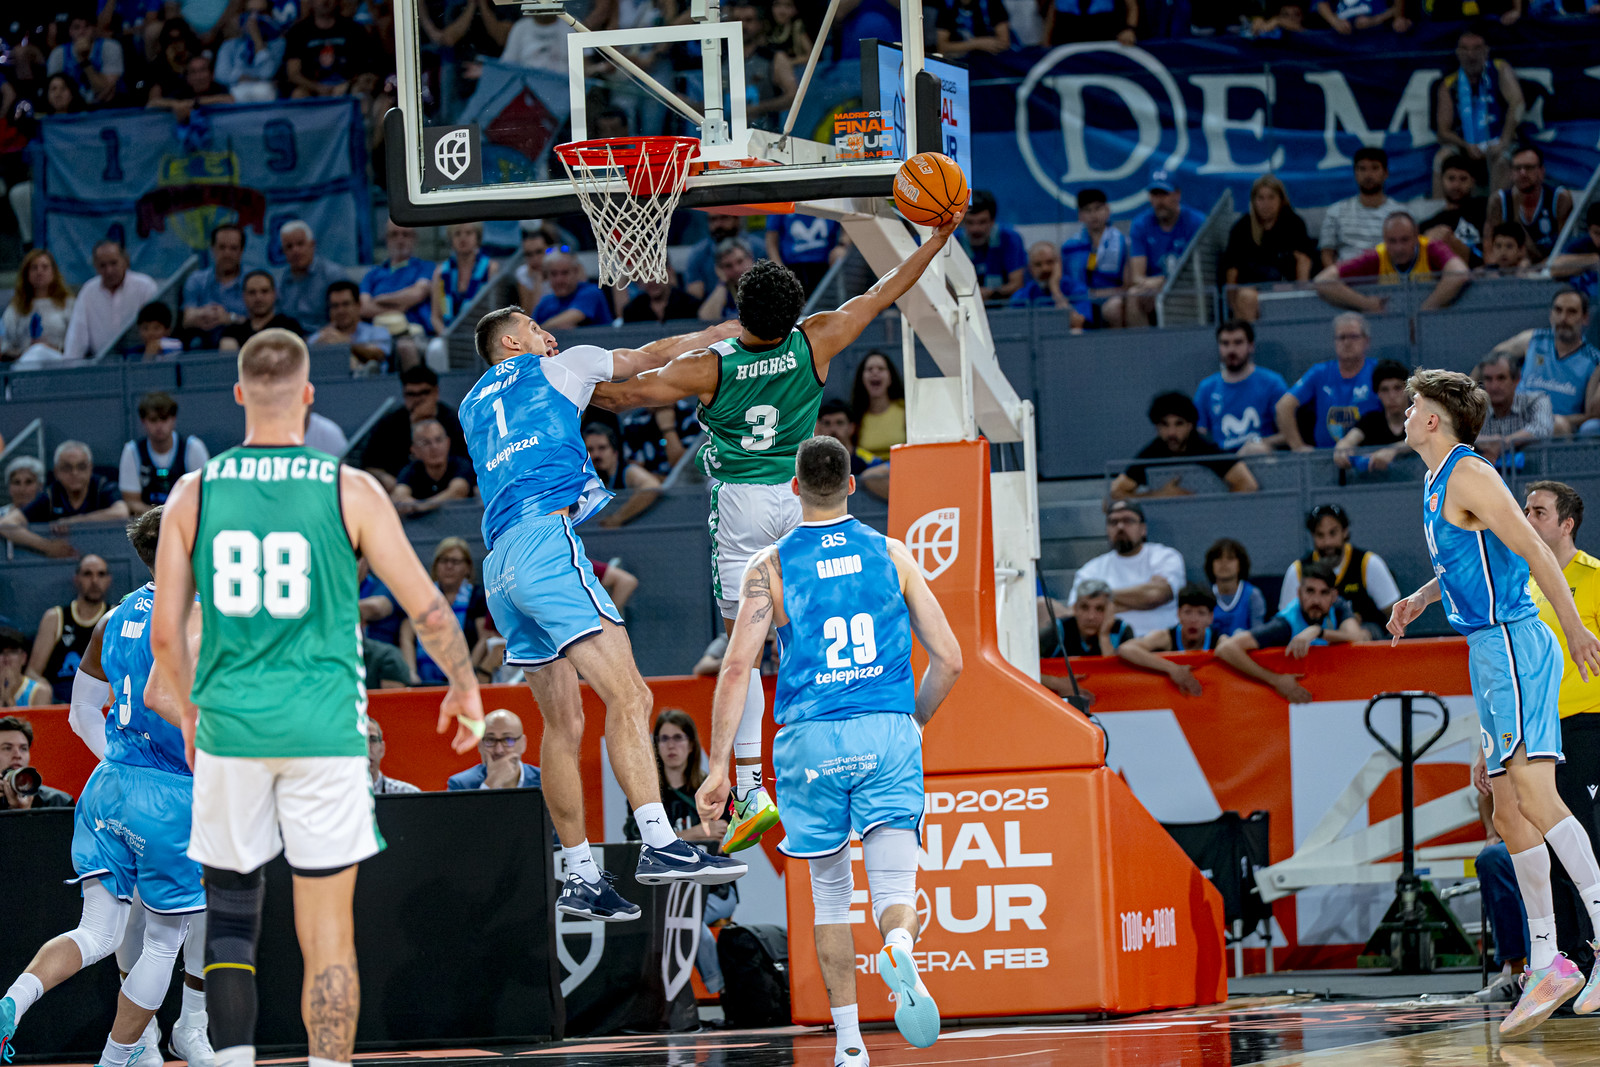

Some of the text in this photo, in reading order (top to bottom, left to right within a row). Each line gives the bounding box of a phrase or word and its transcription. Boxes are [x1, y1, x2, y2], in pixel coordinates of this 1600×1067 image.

[834, 118, 894, 135] FINAL
[1043, 67, 1600, 184] DEME
[495, 360, 516, 376] as
[735, 351, 798, 380] HUGHES
[492, 396, 509, 439] 1
[740, 404, 780, 451] 3
[485, 435, 539, 472] telepizza
[938, 512, 955, 520] FEB
[820, 531, 847, 548] as
[213, 529, 312, 620] 88
[816, 554, 863, 579] GARINO
[823, 612, 877, 669] 29
[815, 665, 884, 685] telepizza
[119, 674, 132, 726] 3
[925, 788, 1049, 814] ID2025
[984, 948, 1049, 970] FEB
